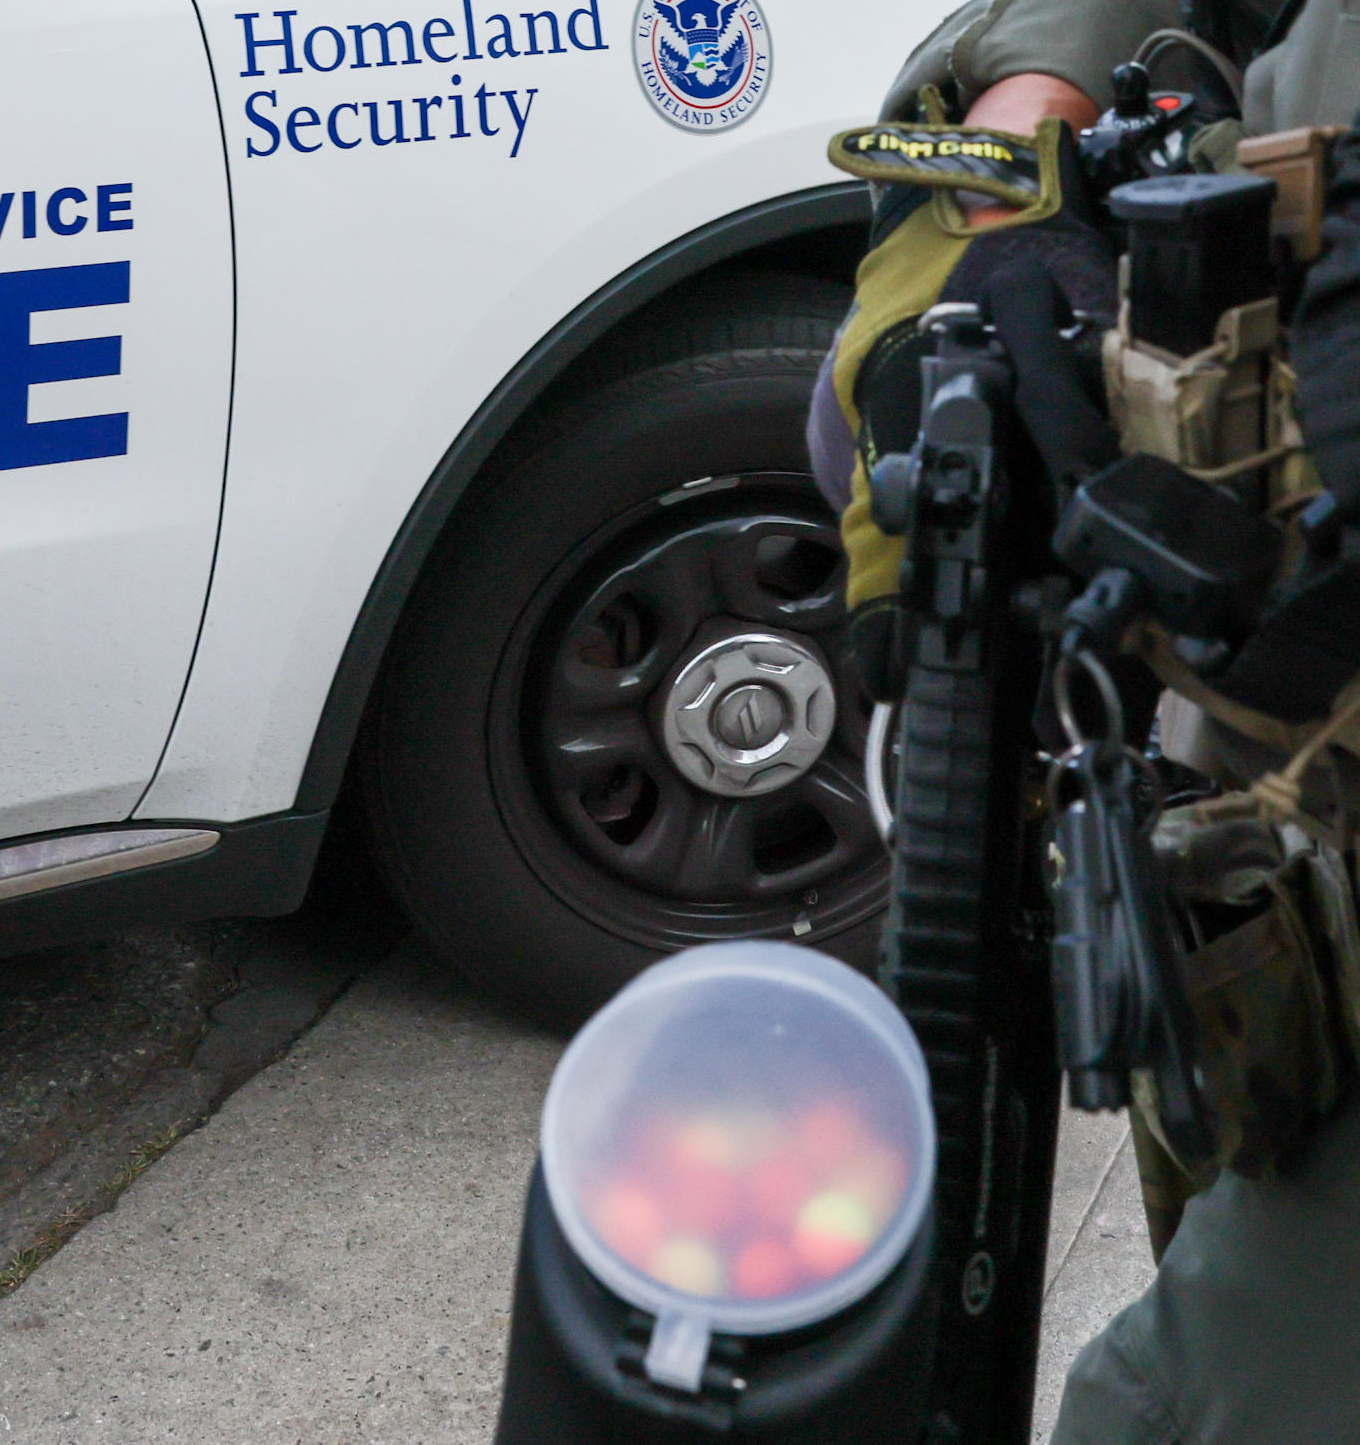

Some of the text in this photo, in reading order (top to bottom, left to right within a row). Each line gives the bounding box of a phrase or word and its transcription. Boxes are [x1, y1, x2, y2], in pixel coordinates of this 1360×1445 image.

[638, 11, 656, 40] U.S.
[746, 9, 764, 32] OF
[244, 73, 539, 158] Security
[641, 52, 768, 125] HOMELAND SECURITY
